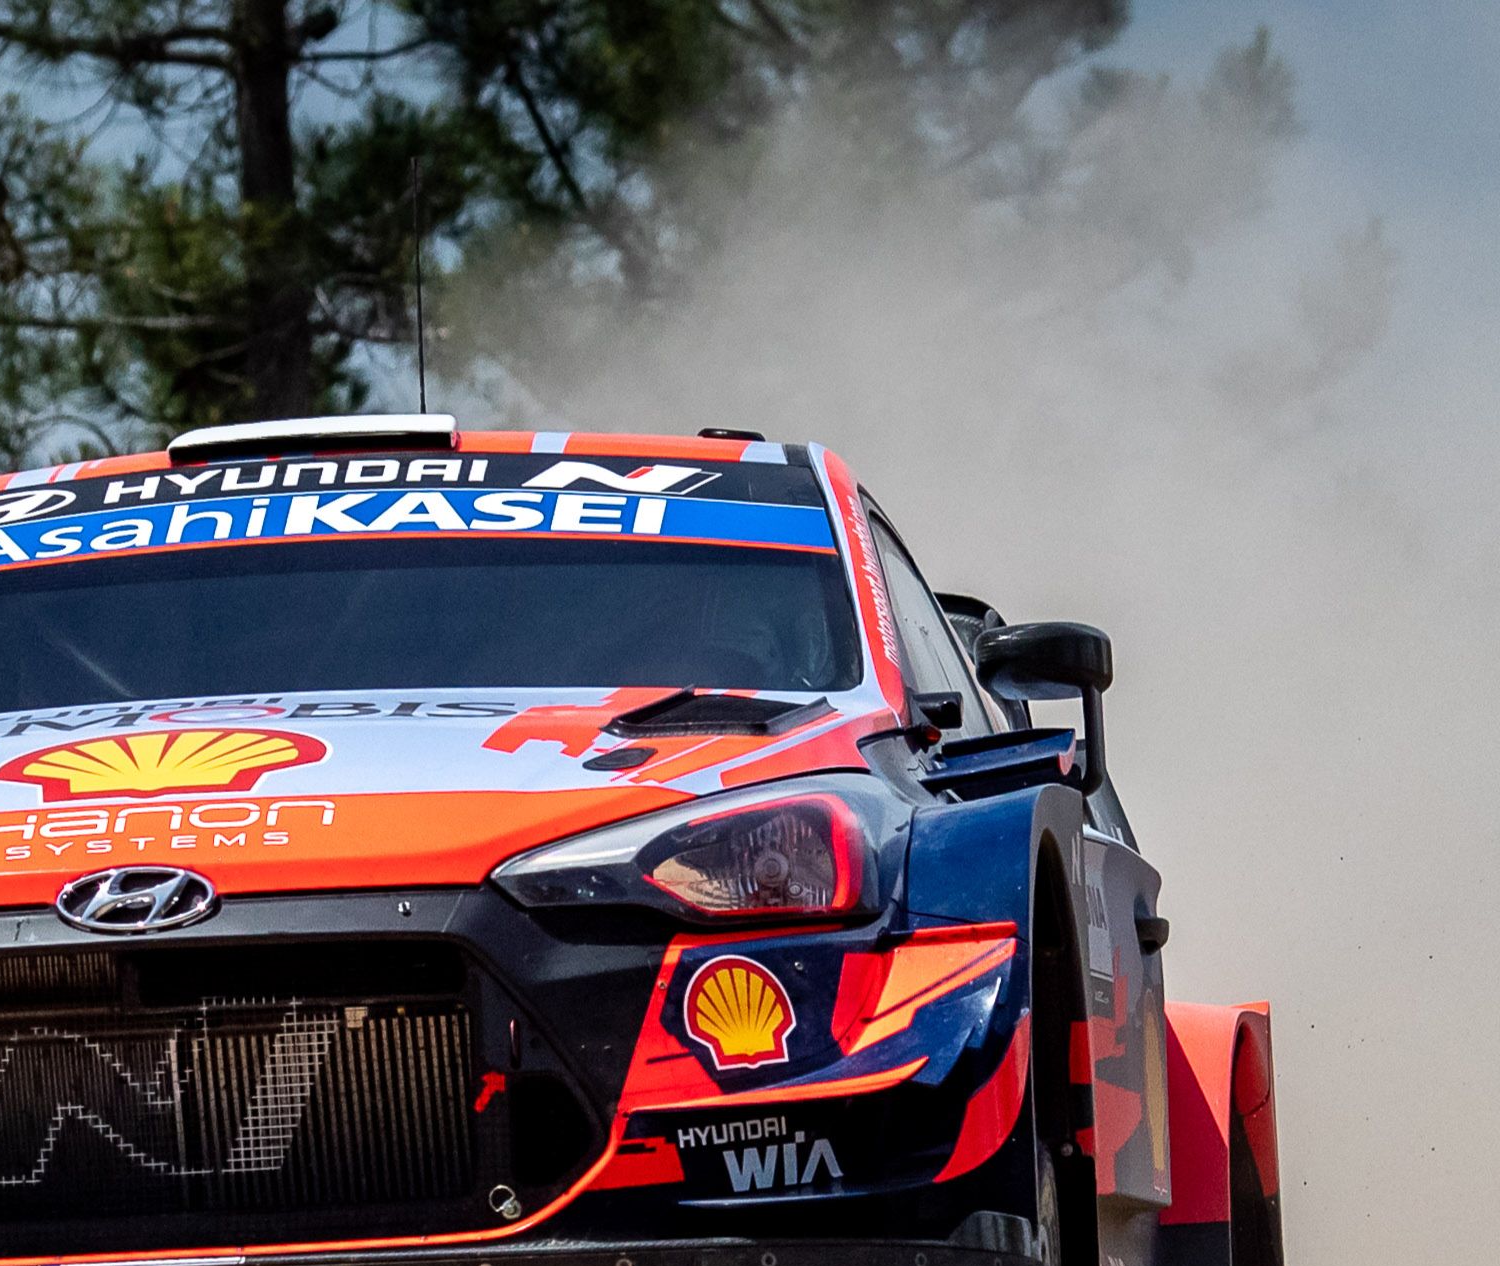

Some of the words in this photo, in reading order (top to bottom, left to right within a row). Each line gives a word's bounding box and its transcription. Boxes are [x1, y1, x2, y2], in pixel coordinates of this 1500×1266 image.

[103, 459, 487, 504] HYUNDAI
[2, 701, 518, 738] MOBIS
[5, 831, 290, 861] SYSTEMS
[677, 1115, 787, 1149] HYUNDAI
[722, 1130, 844, 1193] WIA
